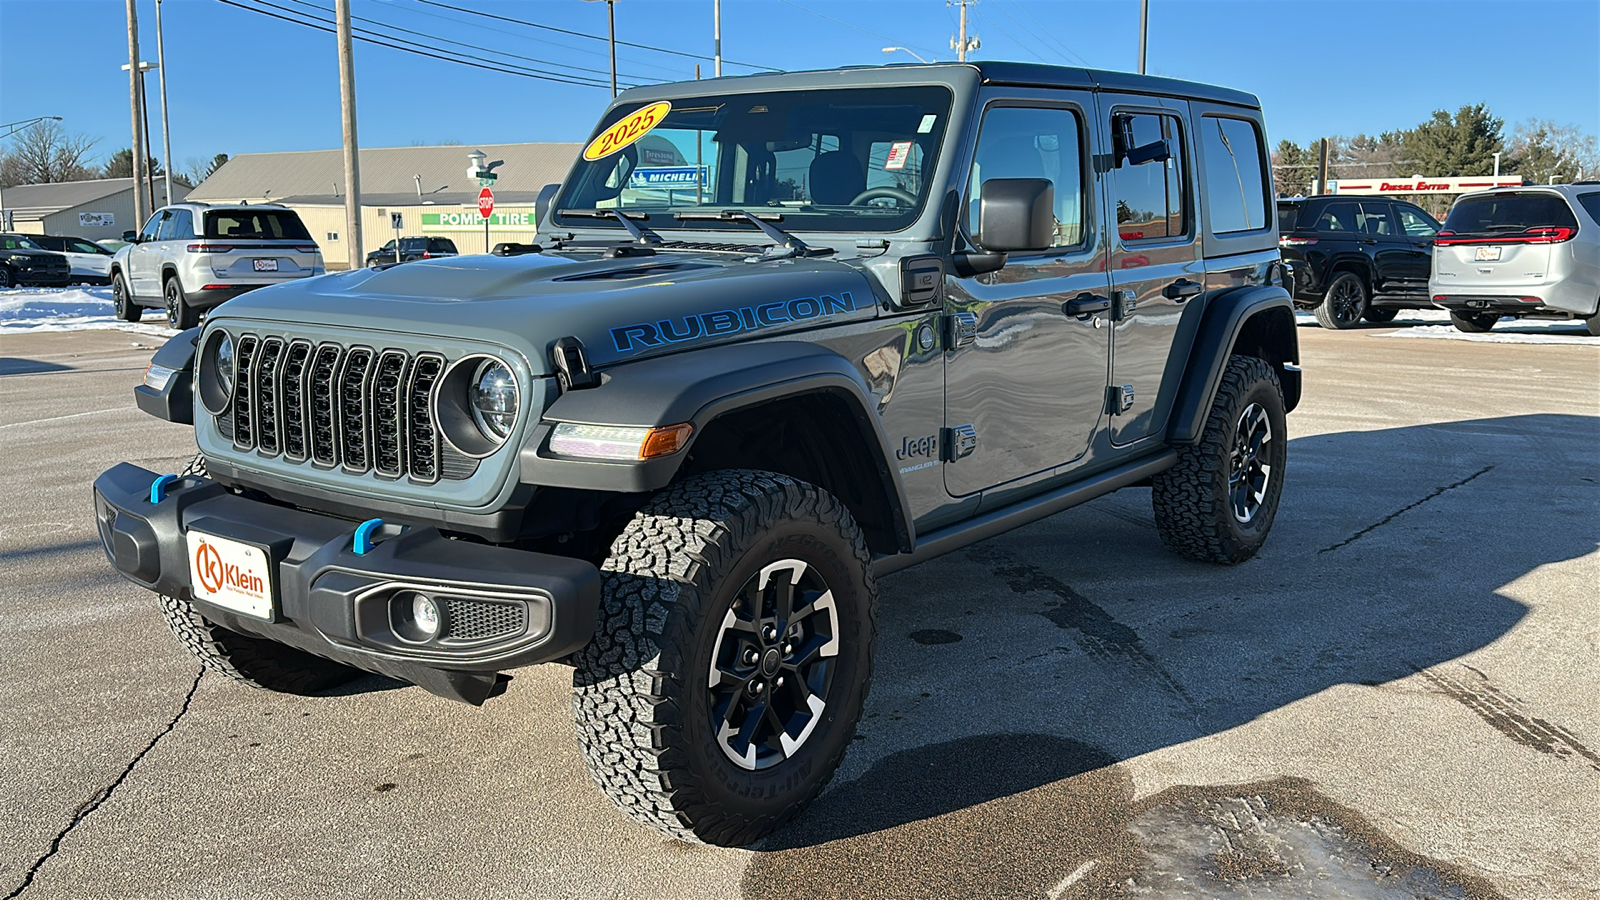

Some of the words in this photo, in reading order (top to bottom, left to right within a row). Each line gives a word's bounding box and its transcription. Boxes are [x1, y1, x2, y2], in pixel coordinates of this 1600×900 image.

[599, 107, 657, 155] 2025
[479, 197, 493, 208] STOP
[496, 213, 529, 224] TIRE
[608, 291, 857, 352] RUBICON
[896, 434, 937, 461] Jeep
[225, 562, 264, 593] Klein
